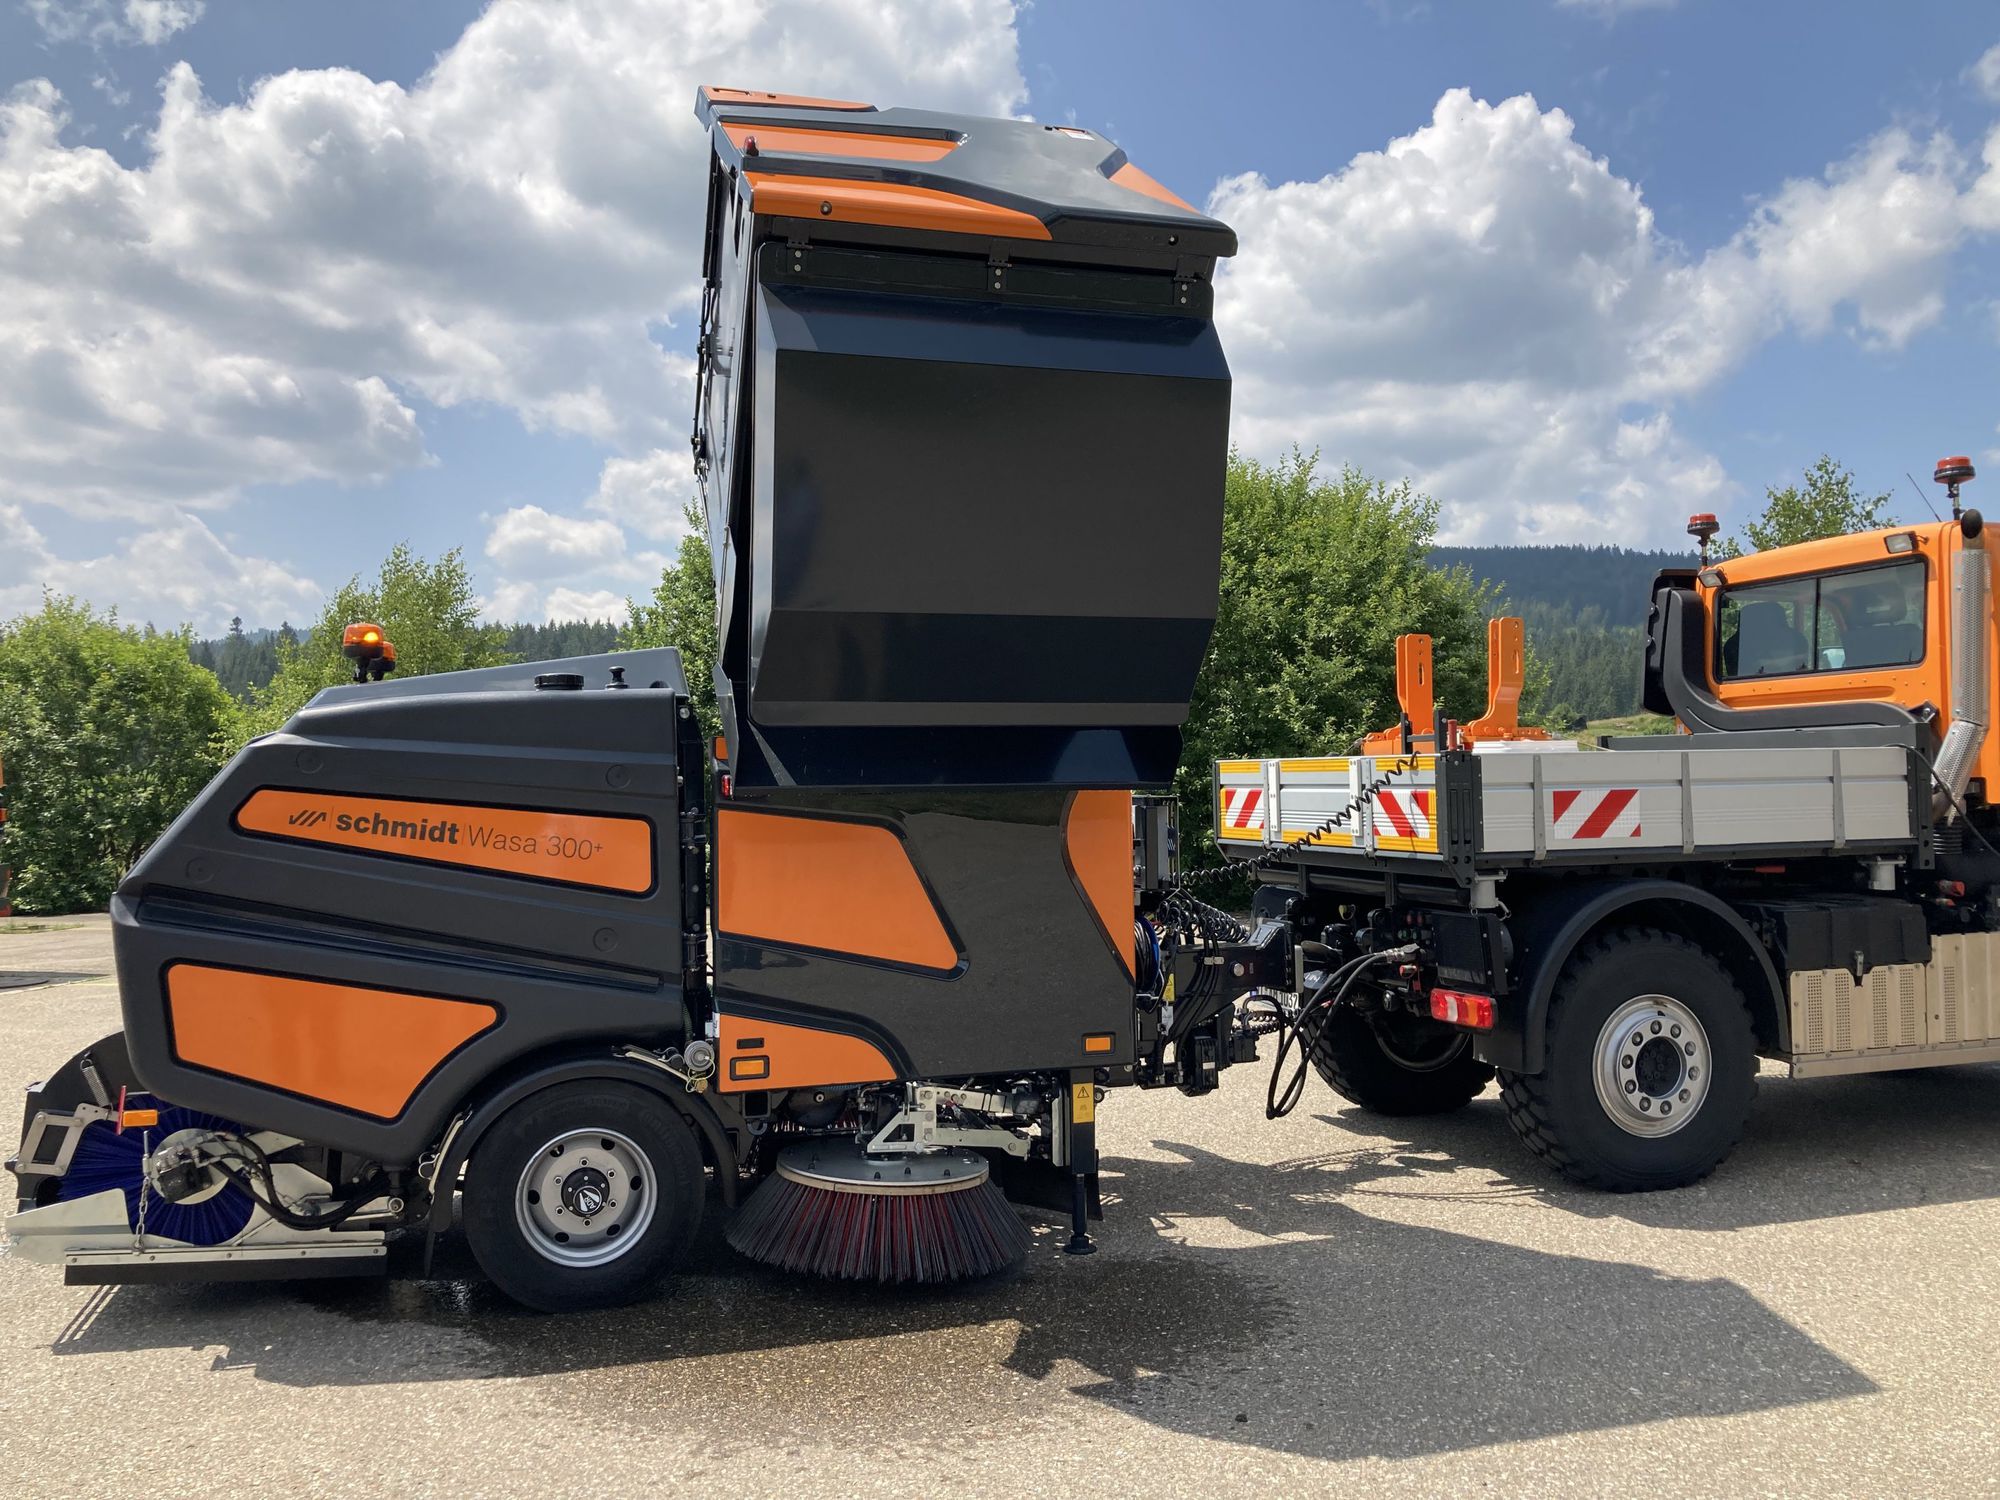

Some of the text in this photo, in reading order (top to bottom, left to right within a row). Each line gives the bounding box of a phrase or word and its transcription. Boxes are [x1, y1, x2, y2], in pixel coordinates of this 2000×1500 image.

[336, 812, 604, 861] schmidt Wasa 300+
[583, 1195, 597, 1209] ADR
